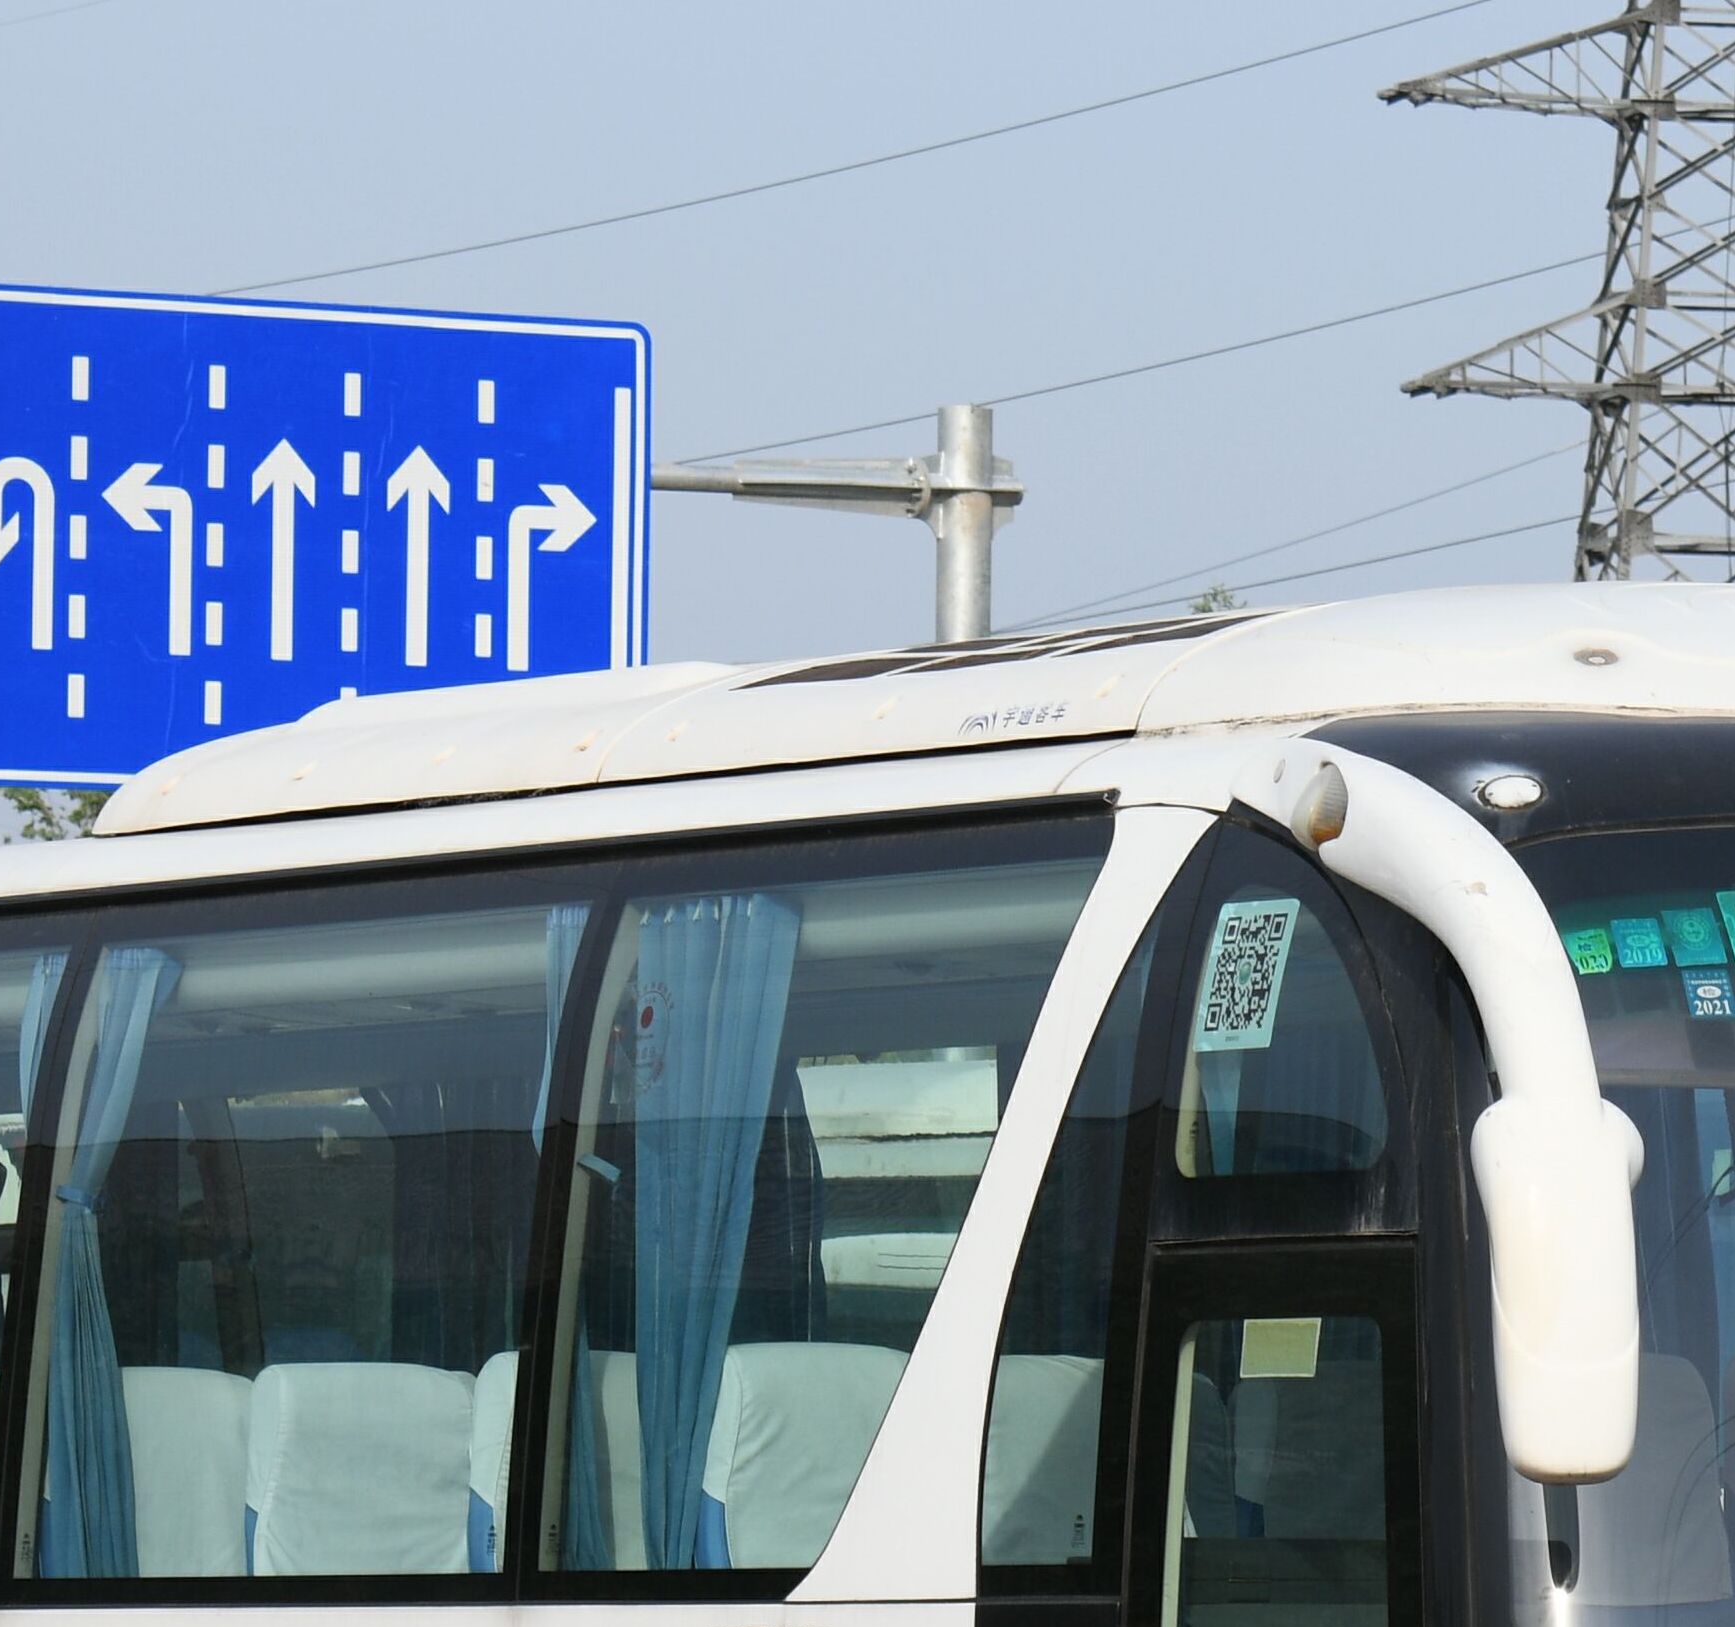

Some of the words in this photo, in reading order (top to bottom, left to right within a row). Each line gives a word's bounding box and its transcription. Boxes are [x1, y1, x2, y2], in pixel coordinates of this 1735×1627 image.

[1575, 953, 1609, 970] 020
[1623, 948, 1662, 964] 2019
[1694, 999, 1732, 1016] 2021
